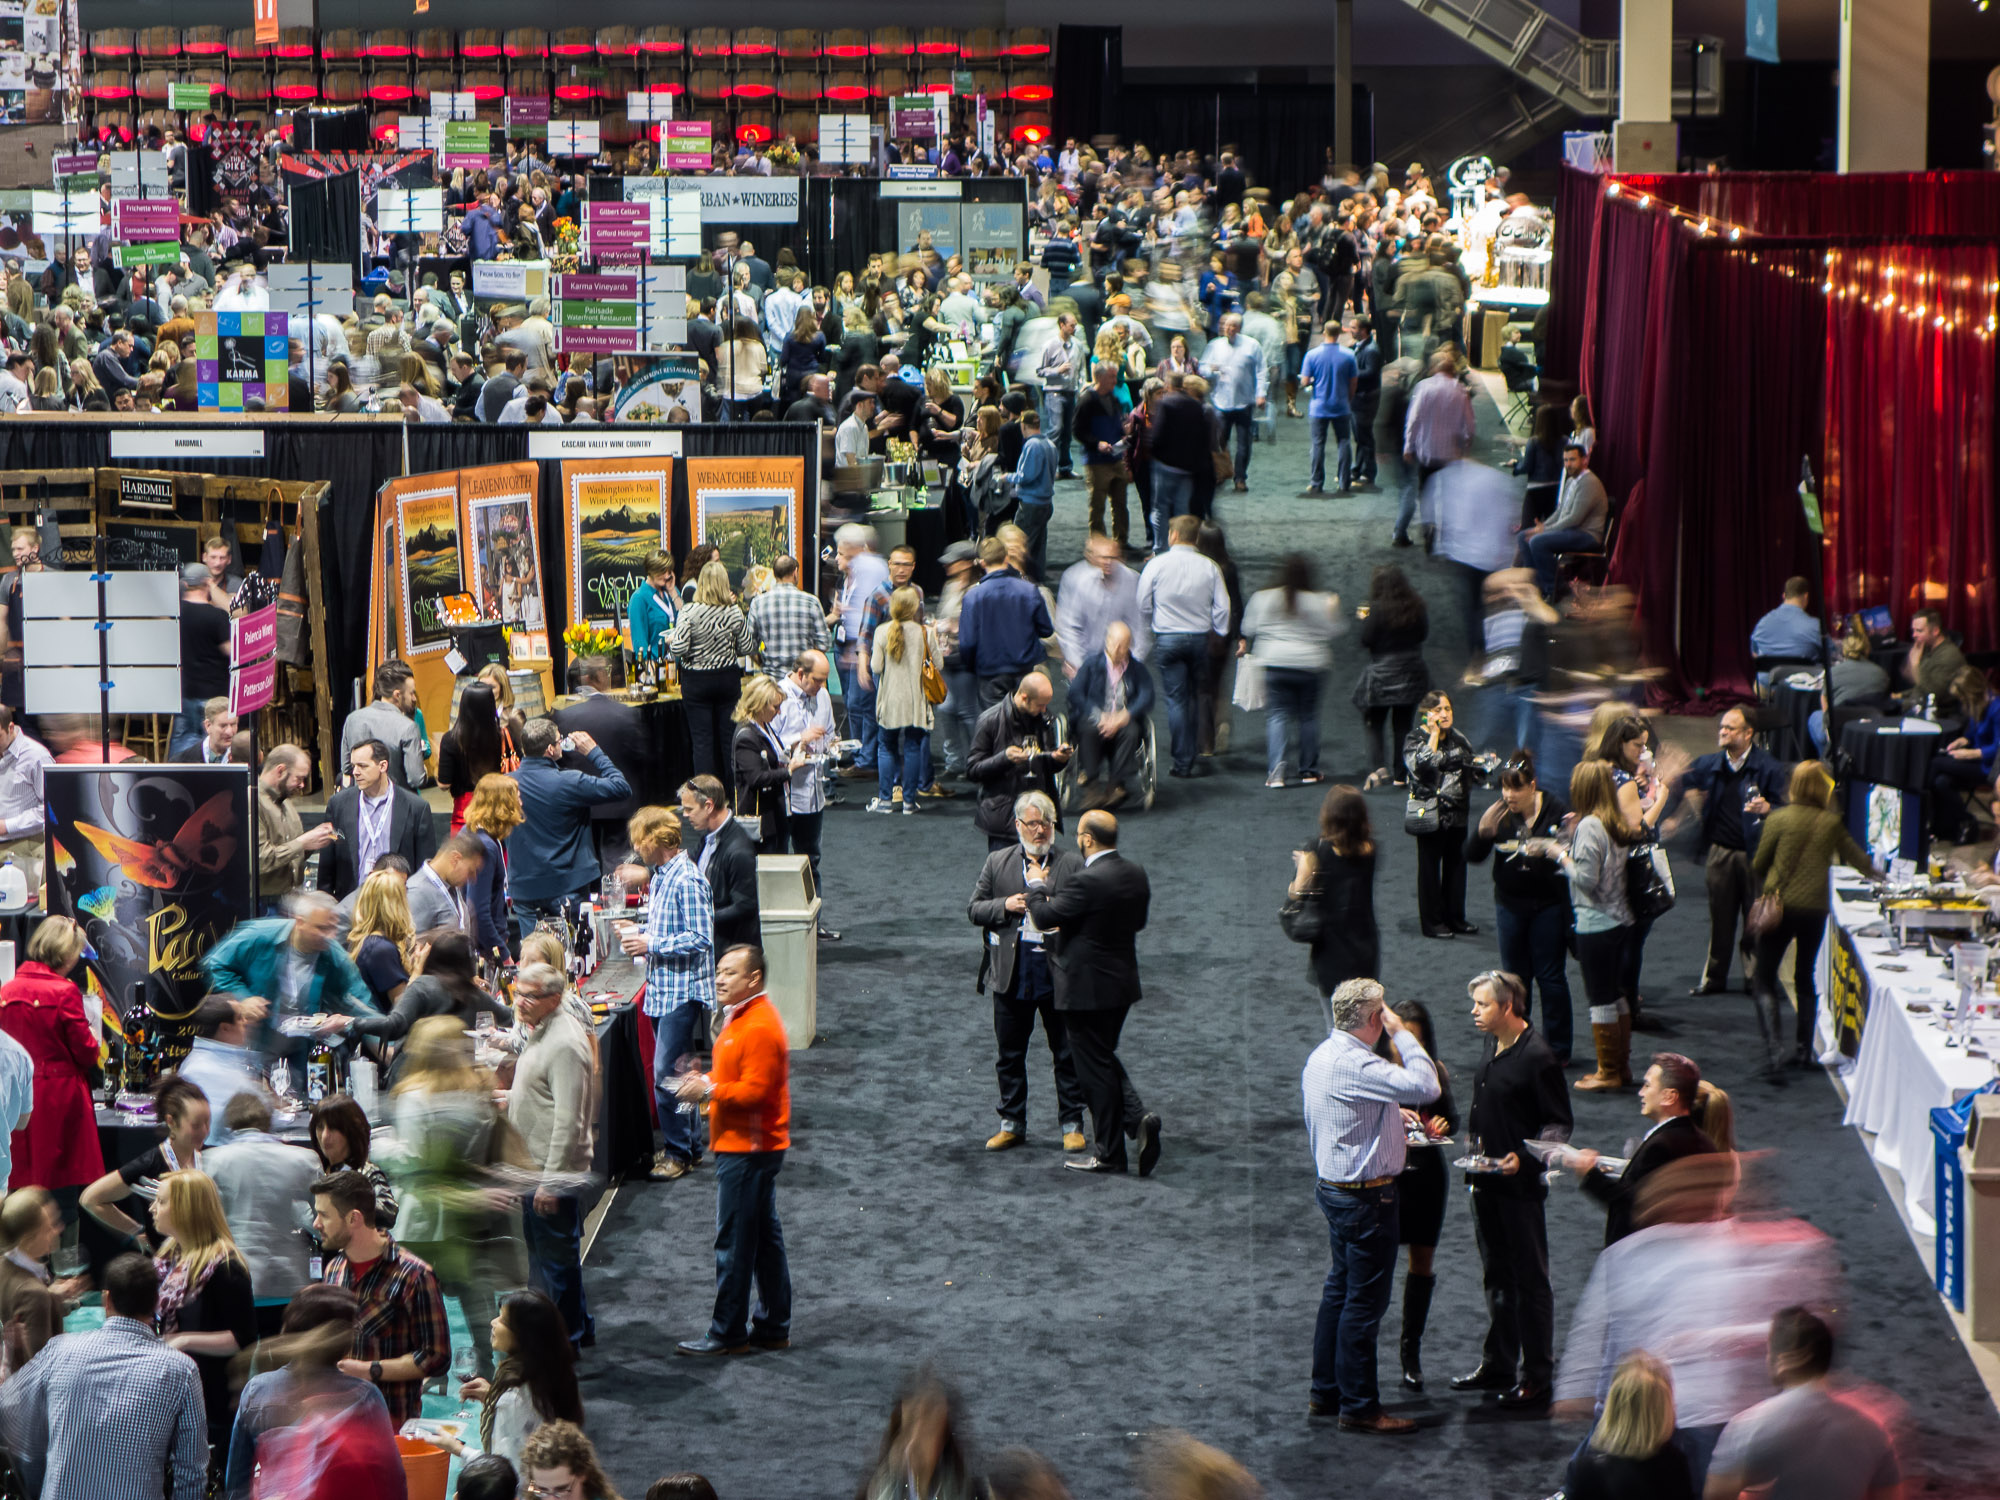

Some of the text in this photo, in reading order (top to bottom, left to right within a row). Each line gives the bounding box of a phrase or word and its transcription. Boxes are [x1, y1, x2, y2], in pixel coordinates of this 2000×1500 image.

[292, 153, 425, 164] THE PIKE BREWING CO.
[225, 162, 246, 170] PIKE
[700, 192, 798, 207] RBAN WINERIES
[126, 204, 172, 214] Frichette Winery
[124, 226, 175, 235] Gamache Vintners
[618, 230, 643, 238] Hirlinger
[570, 282, 628, 292] Karma Vineyards
[584, 306, 614, 314] Palisade
[600, 314, 632, 322] Restaurant
[565, 336, 633, 346] Kevin White Winery
[226, 369, 259, 379] KARMA
[663, 366, 698, 375] RESTAURANT
[174, 439, 203, 448] HARDMILL
[562, 440, 652, 448] CASCADE VALLEY WINE COUNTRY
[697, 471, 795, 484] WENATCHEE VALLEY
[122, 480, 173, 496] HARDMILL
[468, 474, 532, 495] LEAVENWORTH
[587, 483, 654, 496] Washington's Peak
[589, 496, 651, 506] Wine Experience
[407, 500, 450, 513] Washington's Peak
[410, 513, 450, 525] Wine Experience
[588, 571, 646, 592] CASCAD
[244, 623, 273, 645] Palencia Winery
[243, 679, 265, 697] Patterson
[1943, 1162, 1954, 1296] RECYCLE
